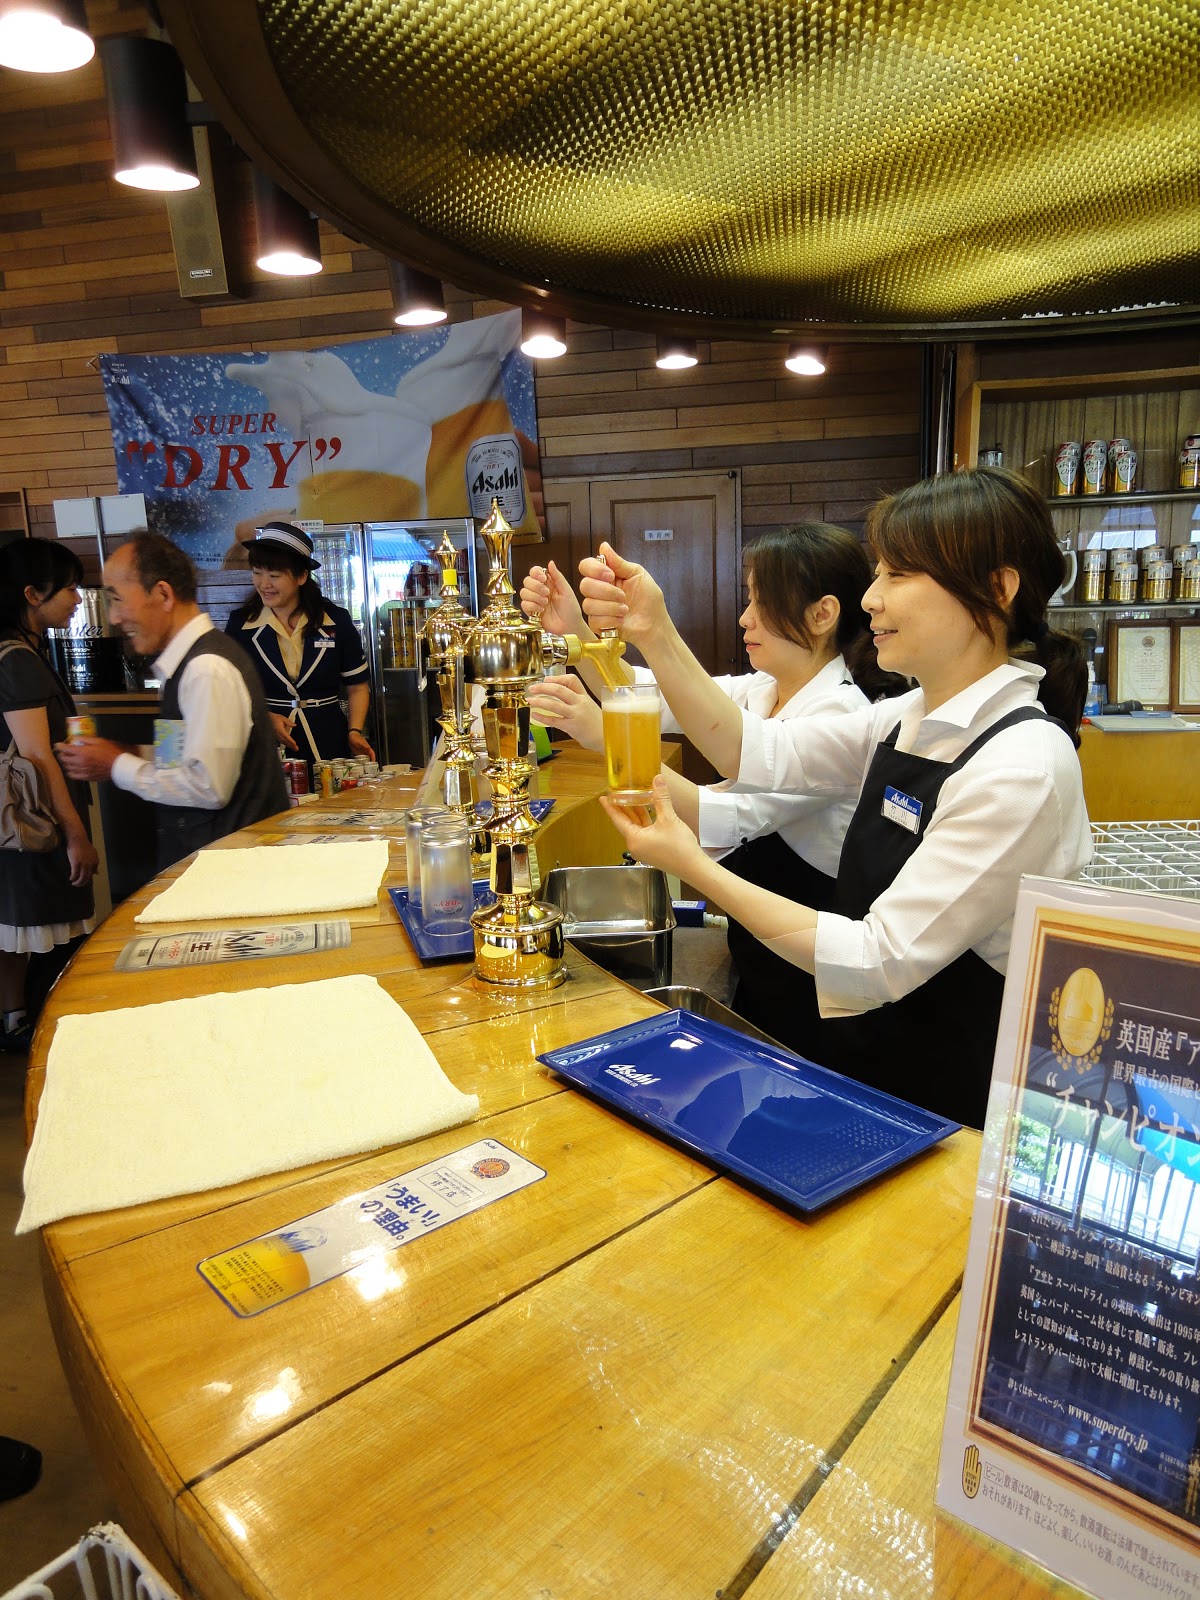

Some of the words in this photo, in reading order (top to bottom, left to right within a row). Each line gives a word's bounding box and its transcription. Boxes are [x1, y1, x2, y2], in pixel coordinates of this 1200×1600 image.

[191, 412, 277, 436] SUPER
[472, 466, 518, 494] Asahi
[890, 792, 909, 809] Asahi
[609, 1064, 661, 1085] Asahi
[1068, 1403, 1149, 1453] www.superdry.jp
